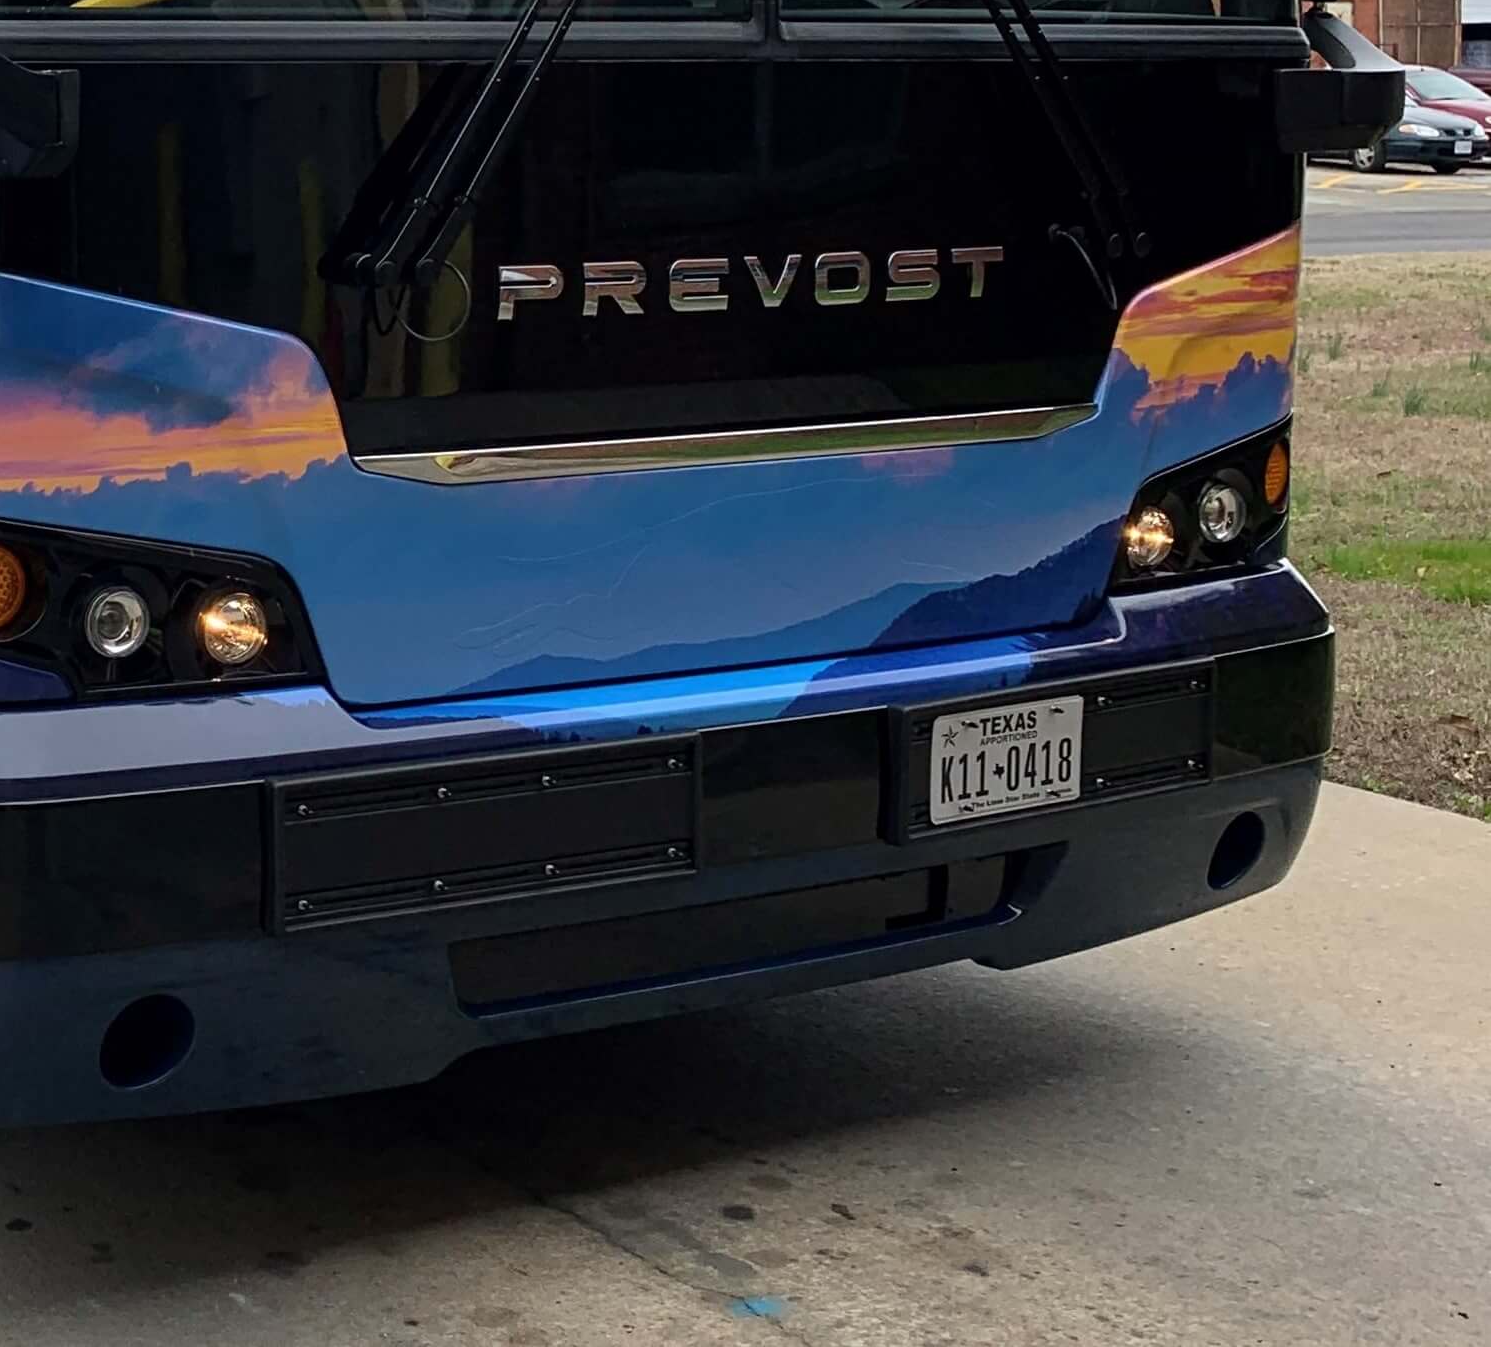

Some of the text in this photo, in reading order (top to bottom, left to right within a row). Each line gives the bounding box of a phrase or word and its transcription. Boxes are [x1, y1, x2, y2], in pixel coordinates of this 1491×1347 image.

[497, 245, 1005, 322] PREVOST
[979, 710, 1038, 737] TEXAS
[980, 730, 1038, 747] APPORTIONED
